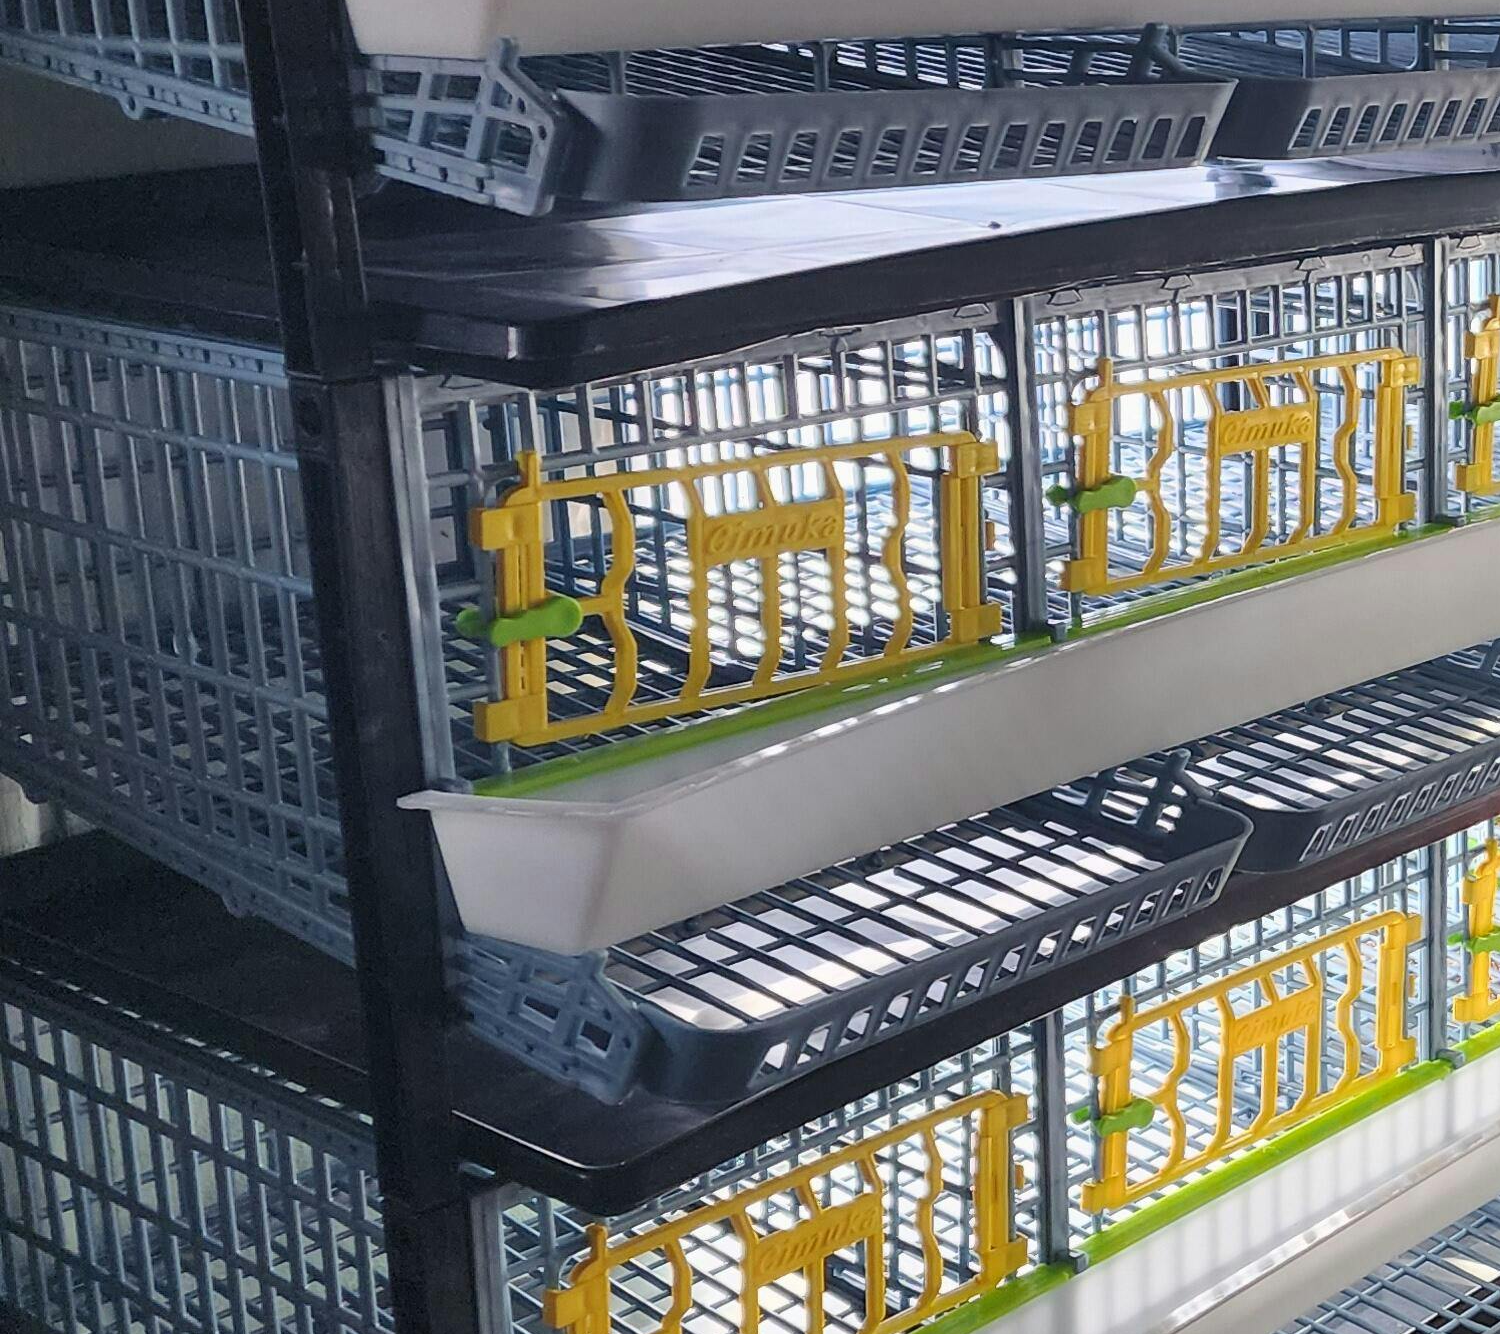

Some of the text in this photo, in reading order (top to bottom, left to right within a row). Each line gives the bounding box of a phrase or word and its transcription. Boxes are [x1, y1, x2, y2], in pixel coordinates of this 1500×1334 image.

[1222, 413, 1311, 446] Cimuka
[708, 511, 838, 554] Cimuka
[758, 1207, 877, 1273] Cimuka
